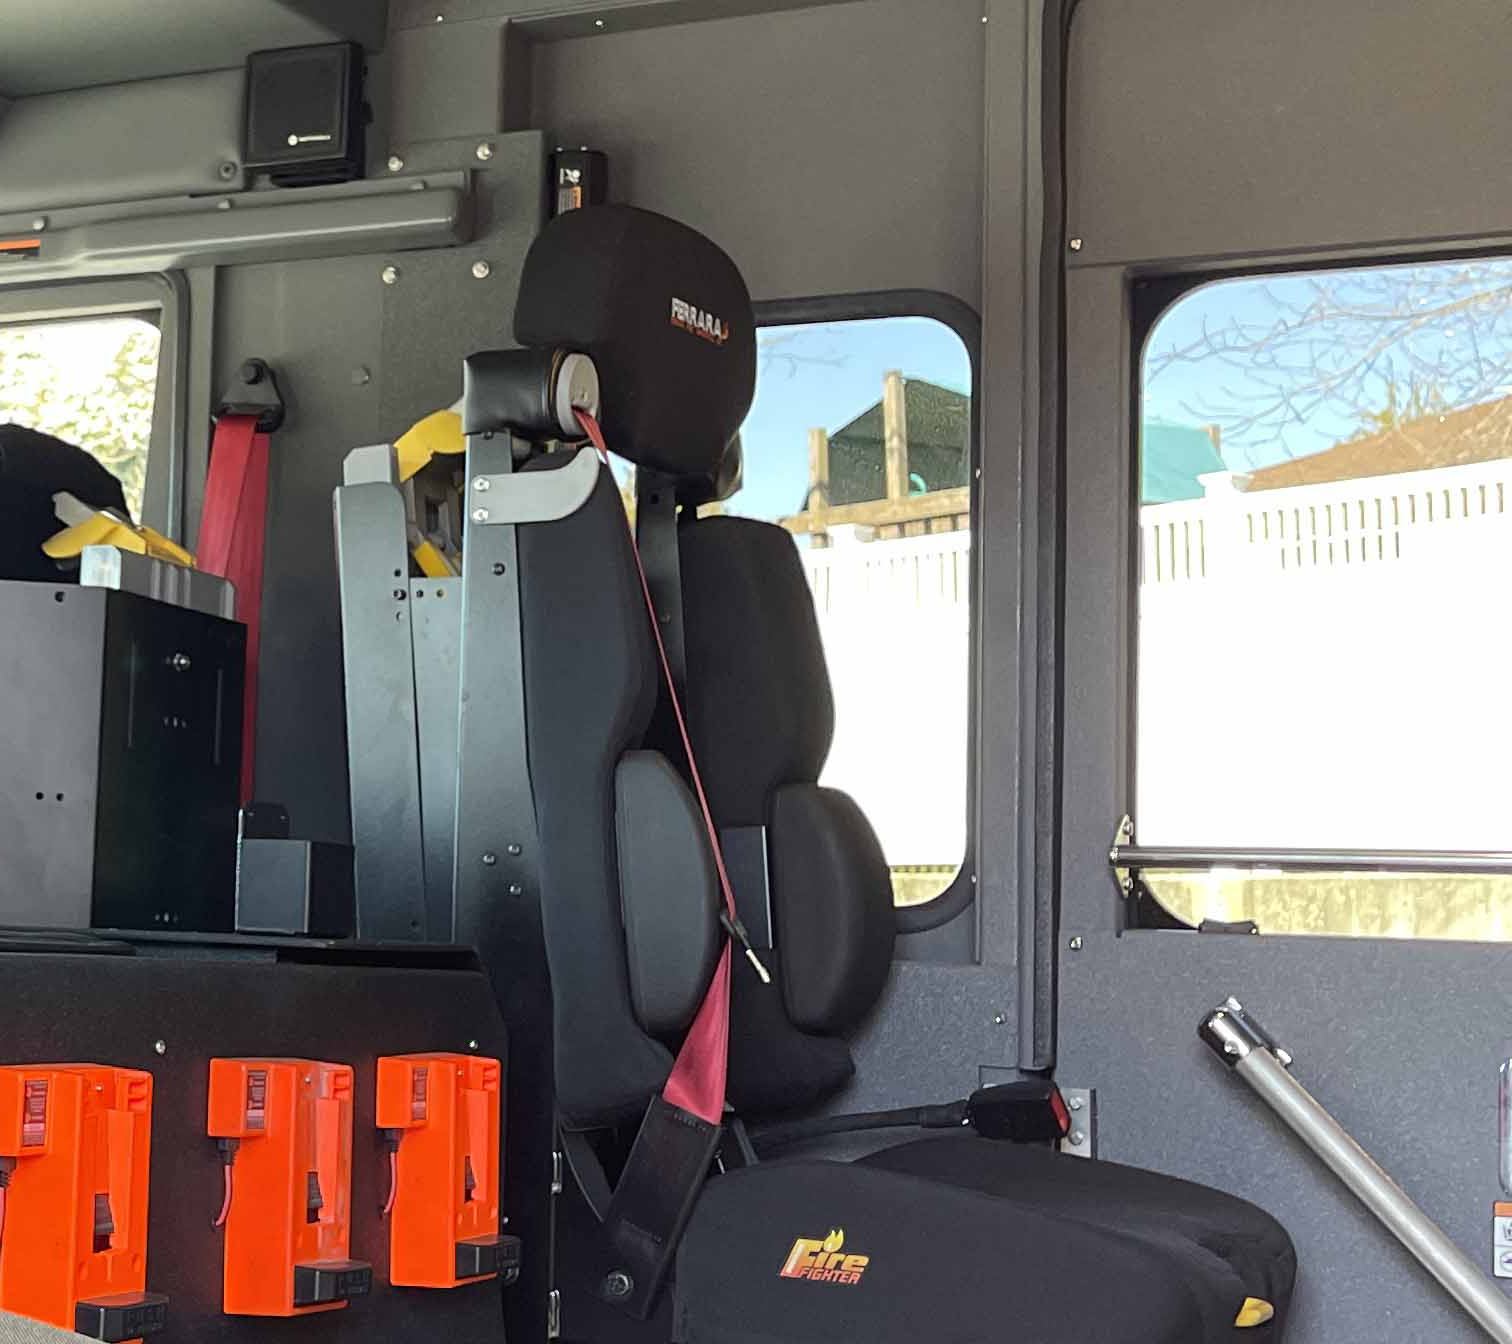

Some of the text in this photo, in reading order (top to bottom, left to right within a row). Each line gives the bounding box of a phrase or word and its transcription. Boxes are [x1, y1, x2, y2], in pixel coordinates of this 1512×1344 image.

[671, 297, 722, 339] FERRARA
[780, 1228, 870, 1279] Fire
[800, 1267, 862, 1285] FIGHTER
